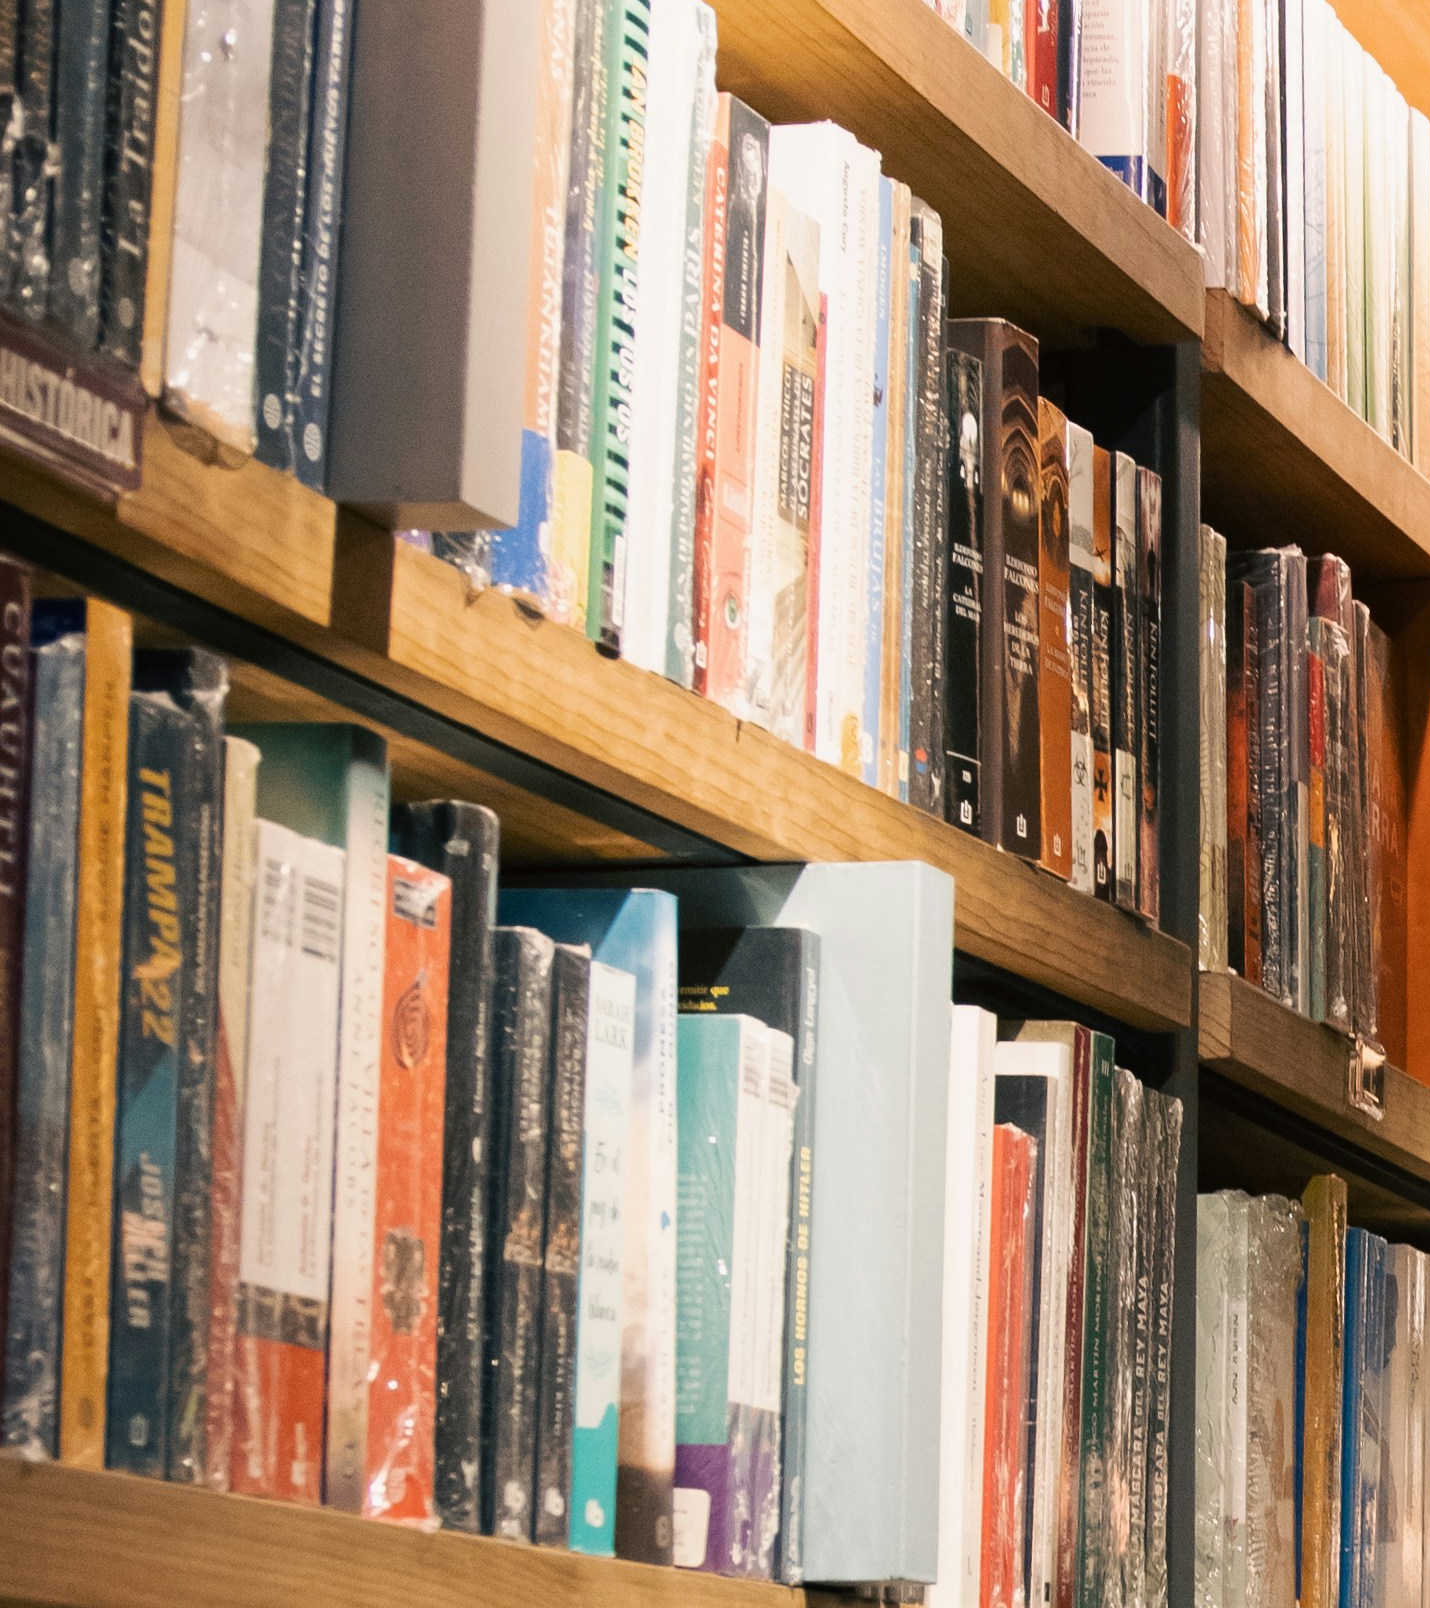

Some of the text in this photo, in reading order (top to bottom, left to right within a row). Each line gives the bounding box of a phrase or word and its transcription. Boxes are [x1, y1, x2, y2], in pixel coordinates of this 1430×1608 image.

[116, 198, 145, 257] La
[321, 181, 335, 224] LOS
[615, 58, 648, 443] JAN BROKKEN LOS JUSTOS
[312, 265, 330, 366] SECRETO
[705, 166, 726, 462] CATERINA DA VINCI
[310, 373, 322, 397] EL
[780, 364, 792, 509] MARCOS CHICOT
[794, 375, 813, 520] SÓCRATES
[1099, 610, 1110, 731] KEN FOLLETT
[1149, 622, 1158, 742] KEN FOLLETT
[133, 766, 183, 1048] TRAMPA 22
[594, 1023, 628, 1051] LARK
[710, 985, 730, 998] que
[799, 1036, 818, 1066] Olga
[791, 1144, 813, 1387] LOS HORNOS DE HITLER
[1087, 1253, 1105, 1408] MARTÍN MORENO
